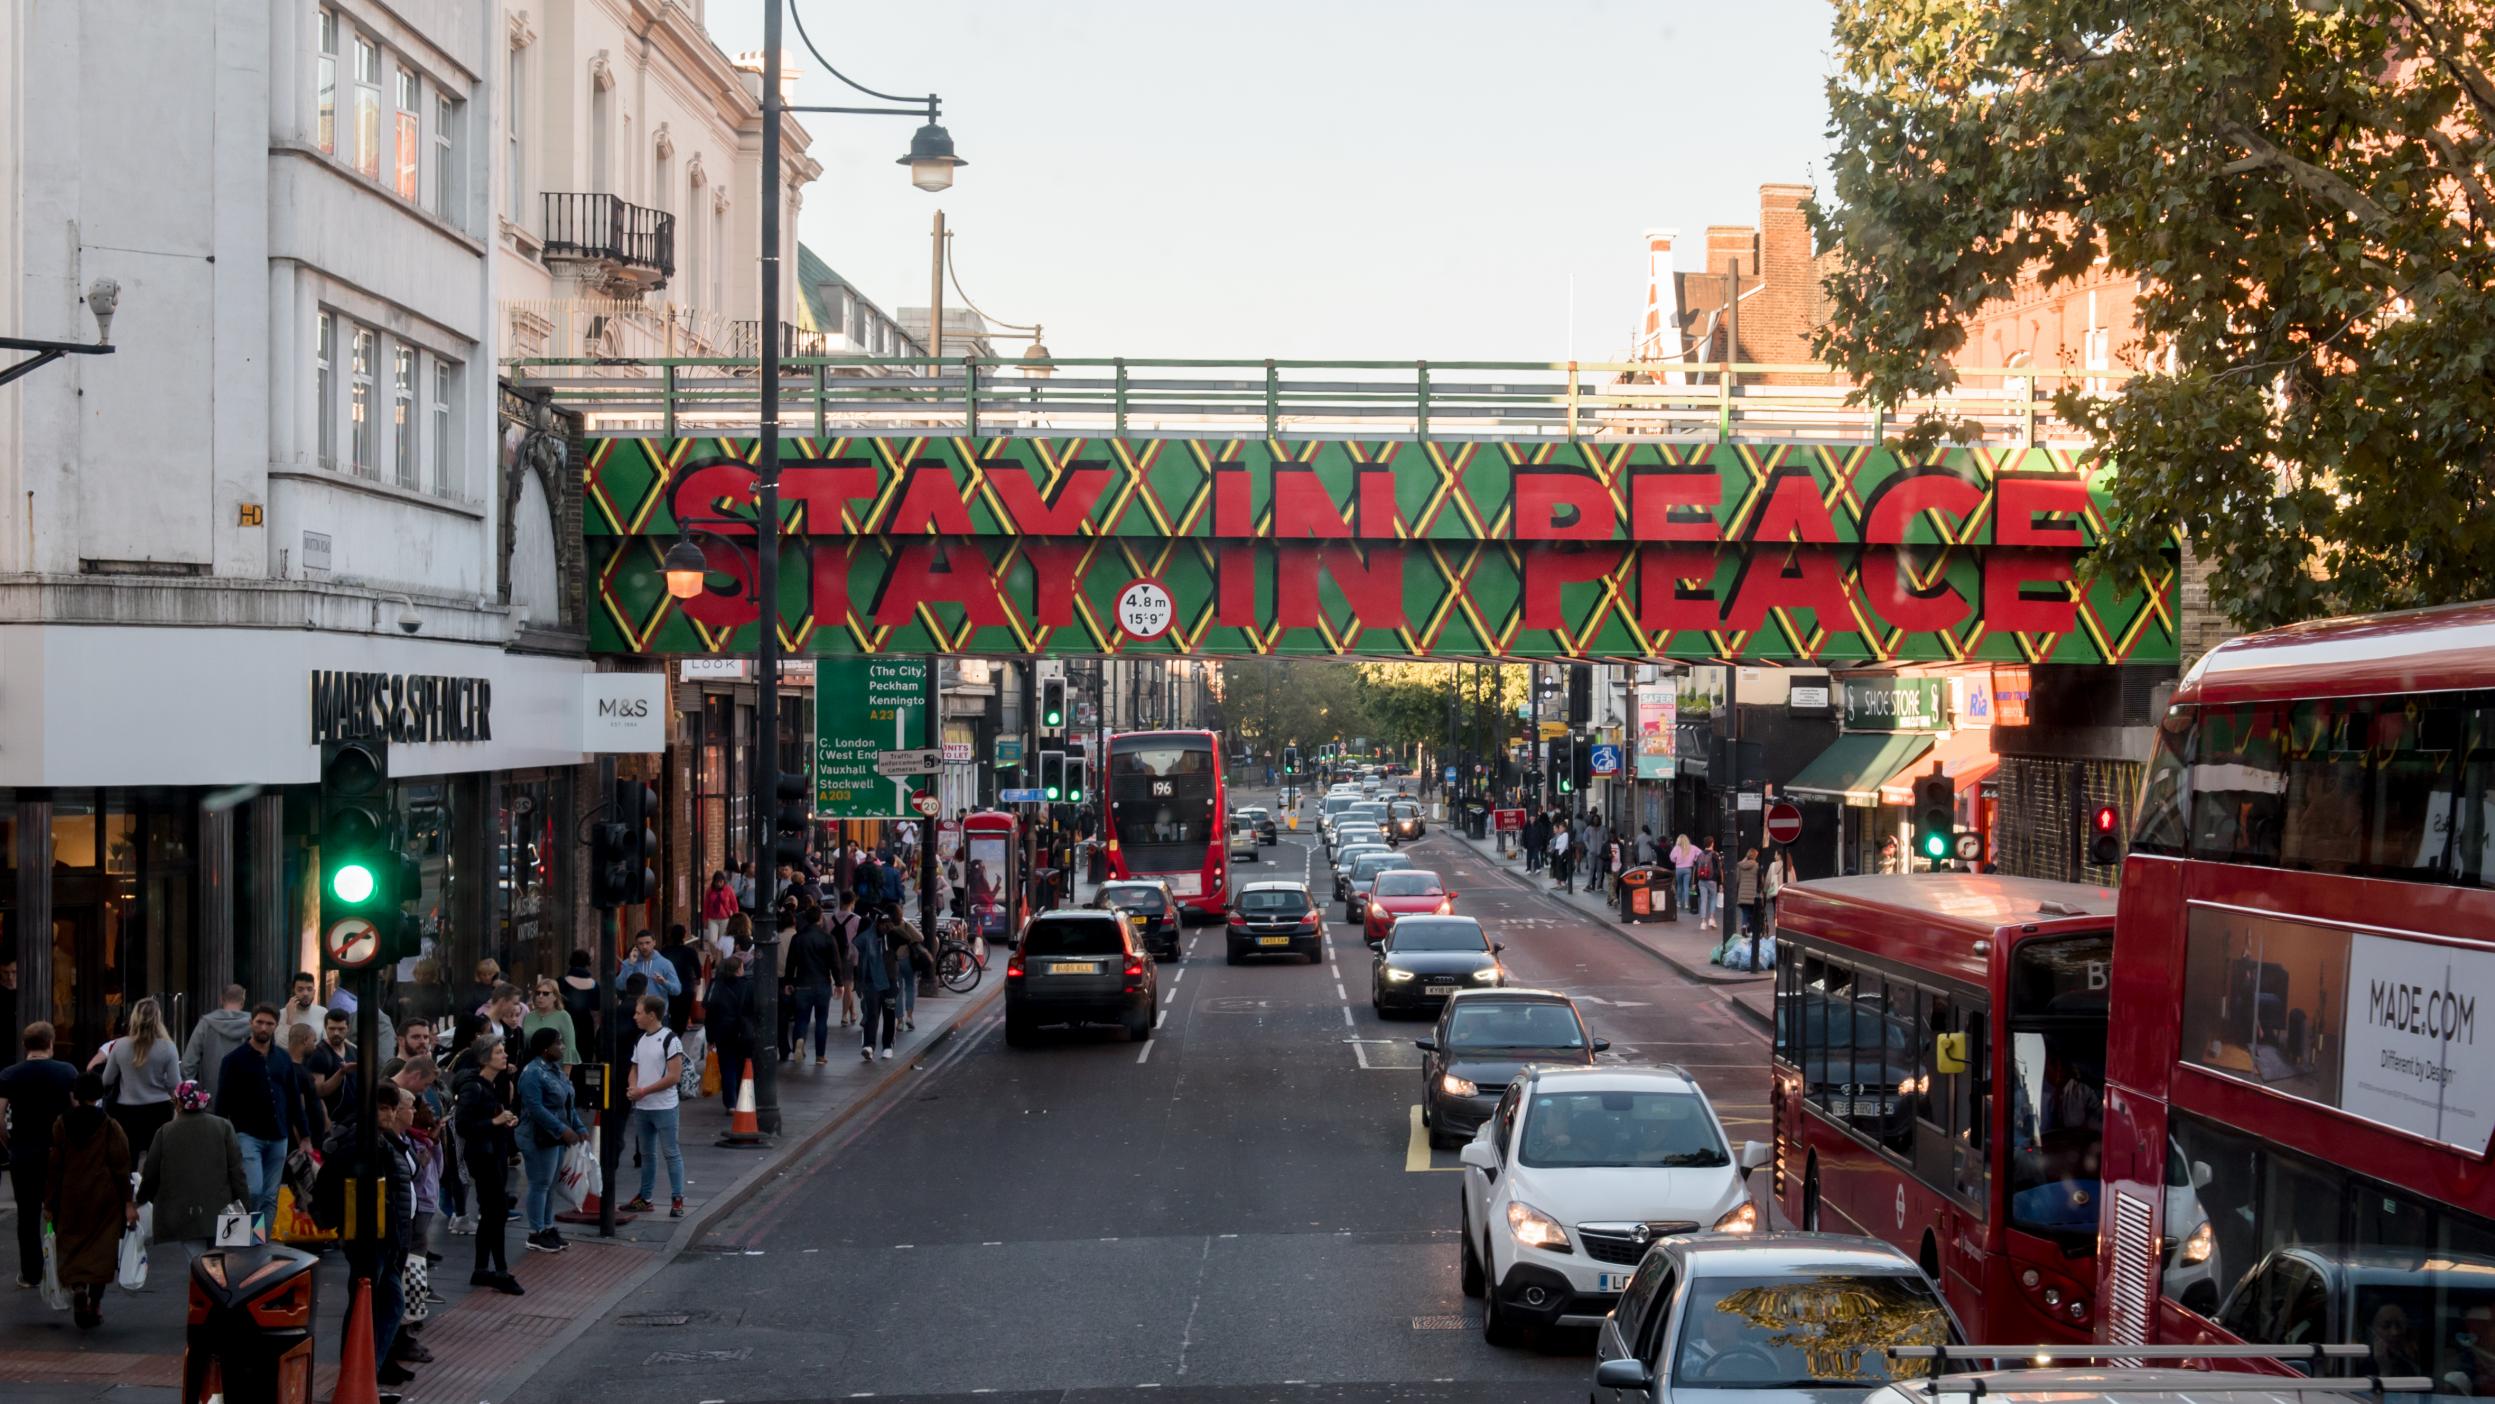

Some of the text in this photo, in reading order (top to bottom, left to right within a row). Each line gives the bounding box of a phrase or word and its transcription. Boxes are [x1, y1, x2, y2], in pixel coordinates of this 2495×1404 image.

[668, 457, 2087, 633] STAY IN PEACE
[691, 660, 736, 669] LOOK
[870, 665, 895, 677] (The
[869, 680, 918, 690] Peckham
[869, 695, 925, 706] Kenningto
[1641, 694, 1674, 703] SAFER
[1864, 690, 1920, 716] SHOE STORE
[1970, 690, 1988, 717] Ria
[599, 698, 648, 717] M&S
[870, 710, 895, 720] A23
[819, 737, 876, 748] C. London
[819, 749, 878, 760] (West End
[819, 764, 866, 774] Vauxhall
[819, 779, 874, 789] Stockwell
[1153, 782, 1172, 795] 196
[819, 790, 852, 800] A203
[923, 802, 938, 811] 20
[2087, 961, 2108, 990] B
[2369, 978, 2475, 1045] MADE.COM
[2381, 1049, 2414, 1076] Different
[2415, 1056, 2425, 1082] by
